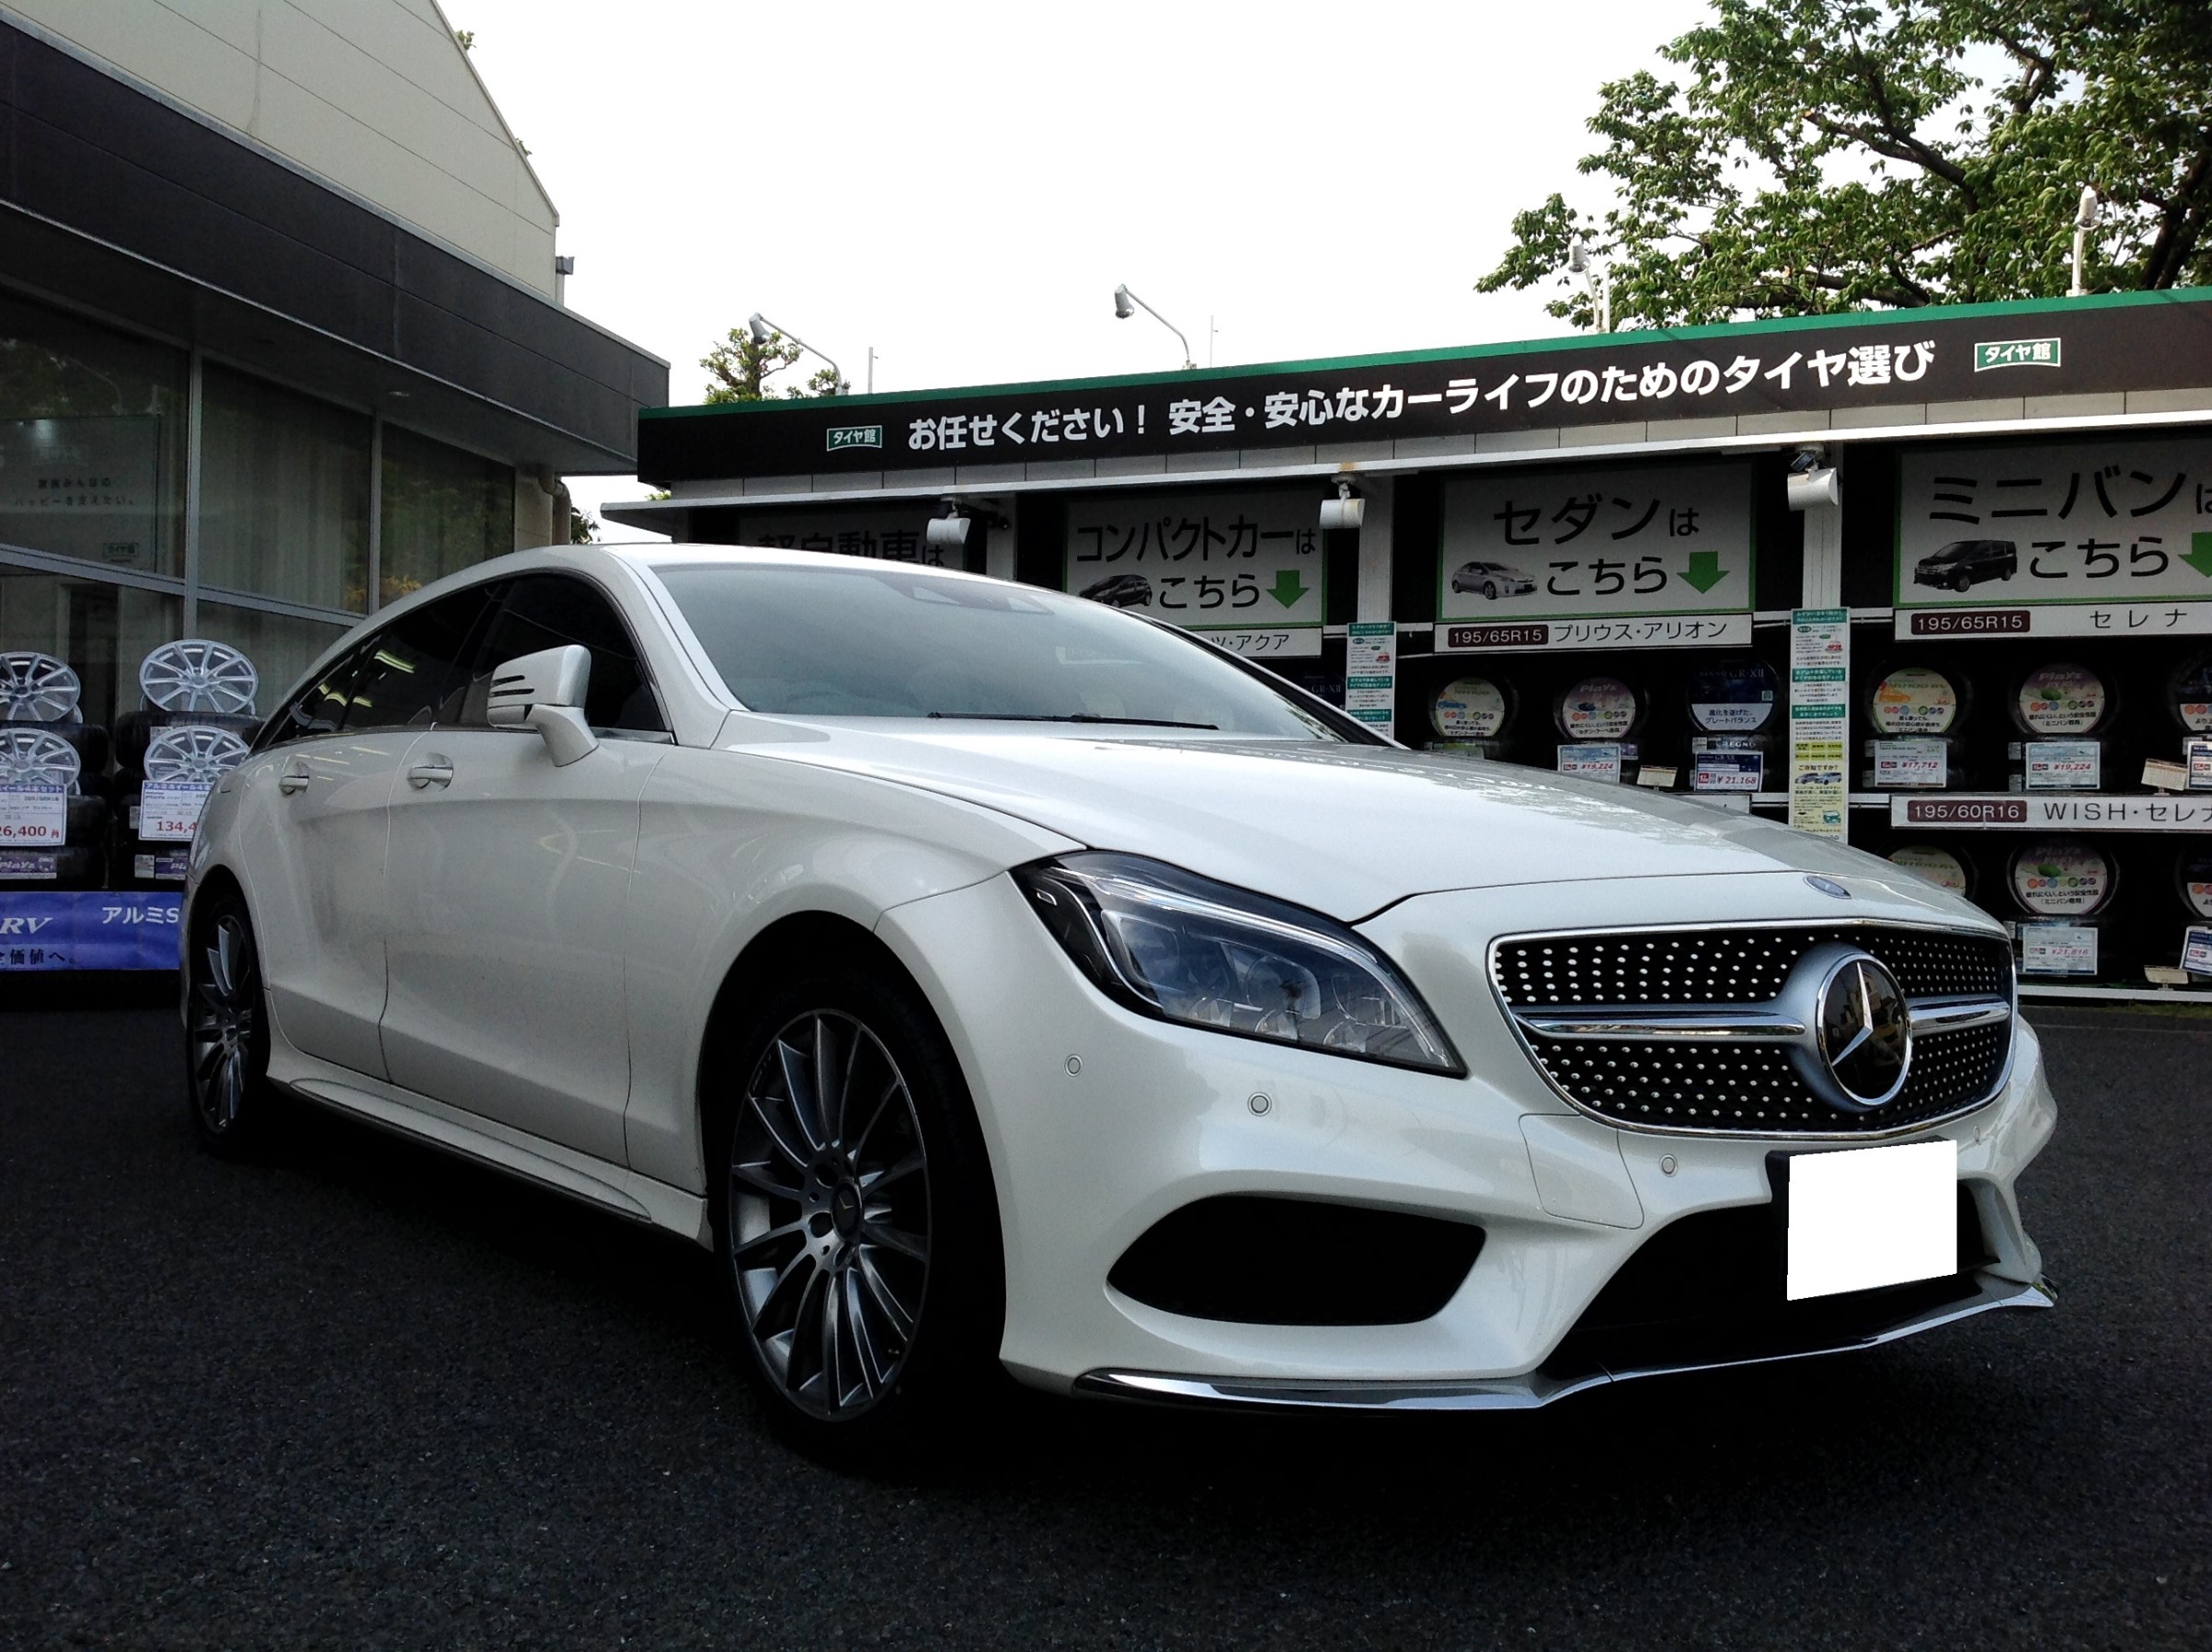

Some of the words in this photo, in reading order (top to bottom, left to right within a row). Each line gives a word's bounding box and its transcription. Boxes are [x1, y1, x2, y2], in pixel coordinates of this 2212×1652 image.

[1985, 342, 2051, 364] タイヤ館
[1168, 339, 1936, 435] 安全・安心なカーライフのためのタイヤ選び
[832, 428, 877, 445] タイヤ館
[1493, 492, 1700, 545] セダンは
[1076, 514, 1316, 563] コンパクトカーは
[2029, 536, 2170, 579] こちら
[1159, 573, 1260, 609] こちら
[1546, 556, 1668, 596] こちら
[1453, 629, 1542, 643] 195/65R15
[1553, 622, 1727, 643] プリウス・アリオン
[1918, 614, 2023, 632] 195/65R15
[1913, 804, 2020, 820] 195/60R16
